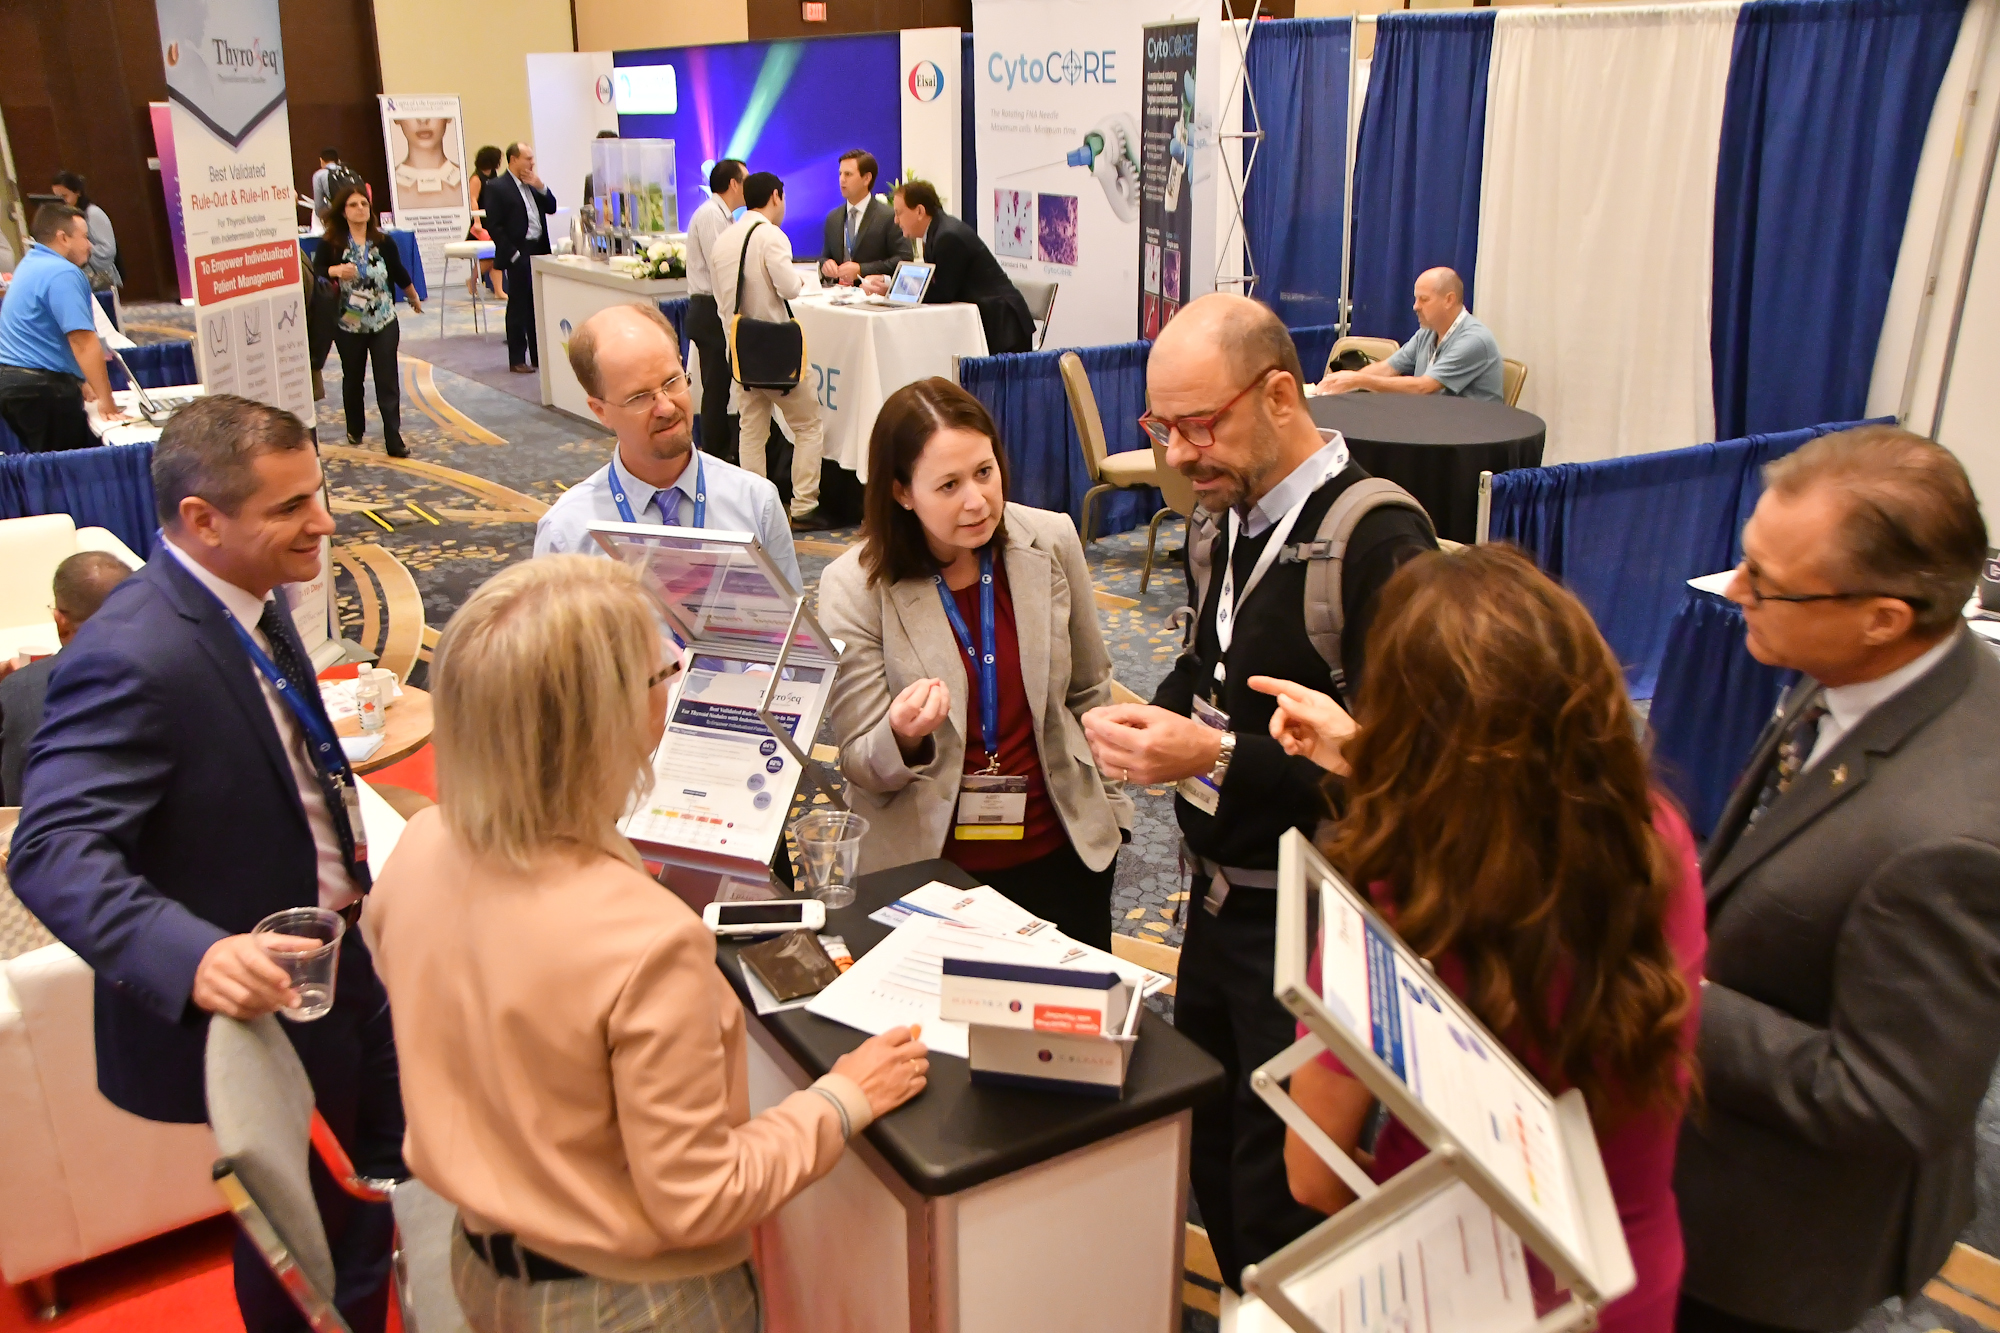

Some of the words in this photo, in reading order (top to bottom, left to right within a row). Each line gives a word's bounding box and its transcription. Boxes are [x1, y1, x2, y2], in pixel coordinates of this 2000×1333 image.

[808, 3, 823, 20] EXIT
[212, 38, 279, 74] ThyroSeq
[916, 74, 936, 87] Eisai
[988, 49, 1117, 91] CytoCORE
[991, 109, 1000, 117] The
[1039, 110, 1059, 119] Needle
[991, 123, 1018, 132] Maximum
[209, 166, 228, 182] Best
[229, 163, 266, 180] Validated
[191, 192, 228, 211] Rule-Out
[231, 190, 238, 206] &
[240, 187, 270, 204] Rule-In
[271, 185, 290, 200] Test
[201, 261, 211, 275] To
[211, 256, 244, 273] Empower
[244, 245, 294, 265] Individualized
[213, 278, 237, 295] Patient
[238, 267, 284, 288] Management
